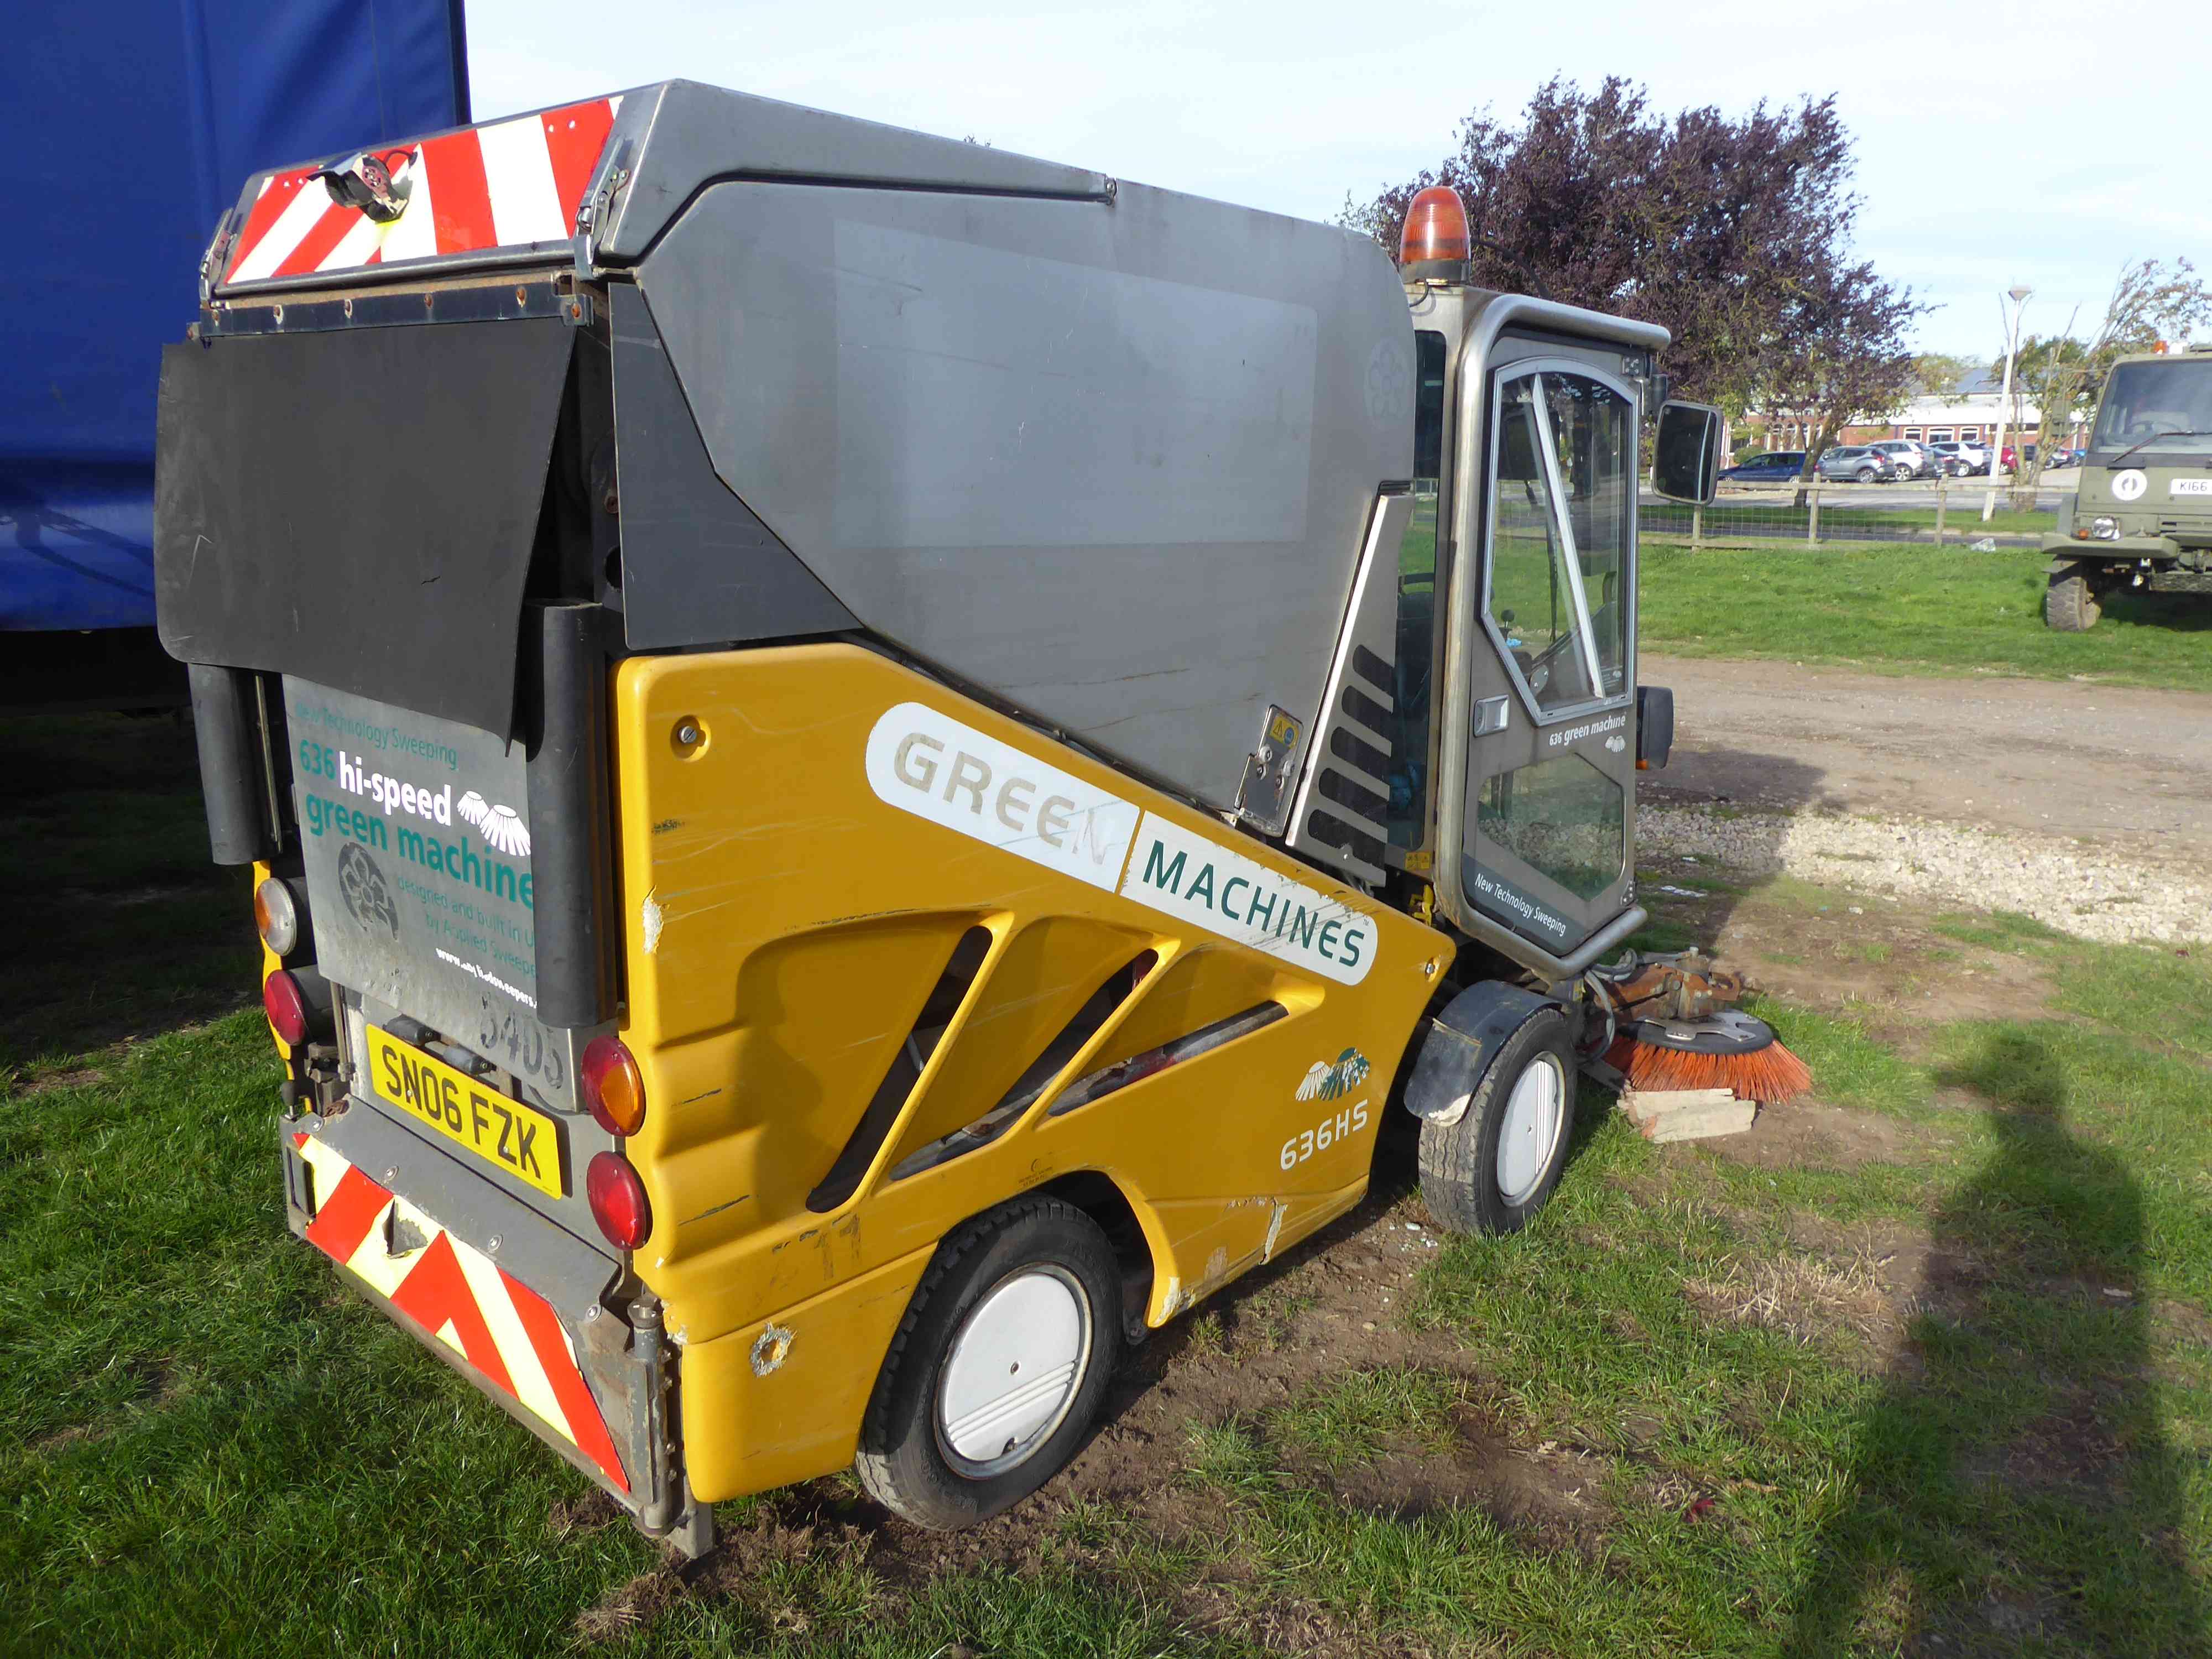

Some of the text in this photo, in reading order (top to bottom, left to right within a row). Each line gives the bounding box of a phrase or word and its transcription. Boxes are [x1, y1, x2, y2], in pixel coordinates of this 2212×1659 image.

[2180, 482, 2208, 492] K166
[392, 728, 458, 771] Sweeping
[1549, 714, 1626, 747] 636 green machine
[299, 738, 452, 827] 636 hi-speed
[305, 792, 533, 911] green machine
[893, 731, 1365, 968] GREEN MACHINES
[1475, 873, 1566, 937] New Technology Sweeping
[382, 1044, 541, 1180] SN06 FZK
[1280, 1099, 1369, 1171] 636HS
